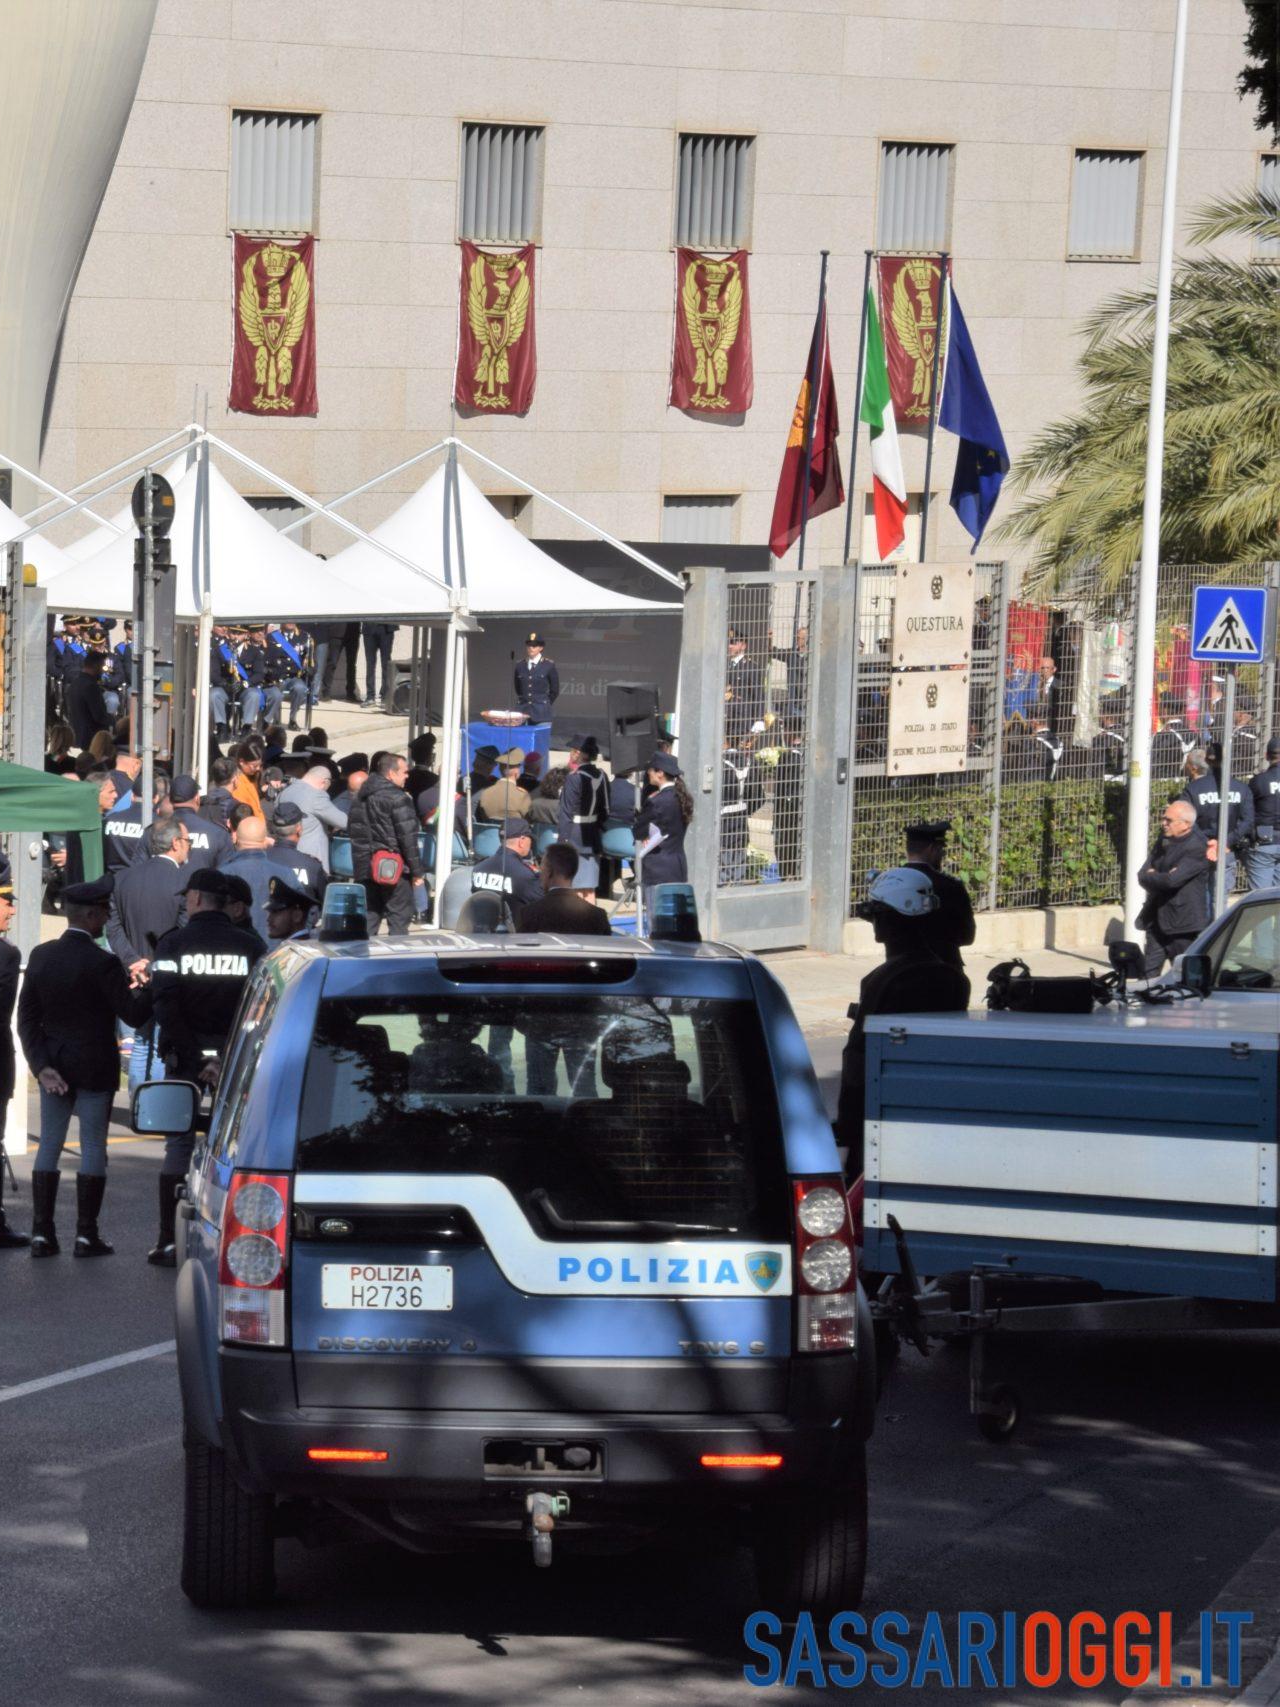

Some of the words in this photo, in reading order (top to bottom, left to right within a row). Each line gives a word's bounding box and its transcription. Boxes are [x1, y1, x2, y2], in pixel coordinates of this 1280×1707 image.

[906, 616, 964, 633] QUESTURA
[904, 724, 925, 733] POLIZIA
[941, 722, 958, 731] STATO
[181, 953, 249, 976] POLIZIA
[350, 1266, 423, 1282] POLIZIA
[558, 1257, 740, 1284] POLIZIA
[351, 1285, 423, 1308] H2736
[318, 1336, 451, 1351] DISCOVERY
[461, 1338, 478, 1352] 4
